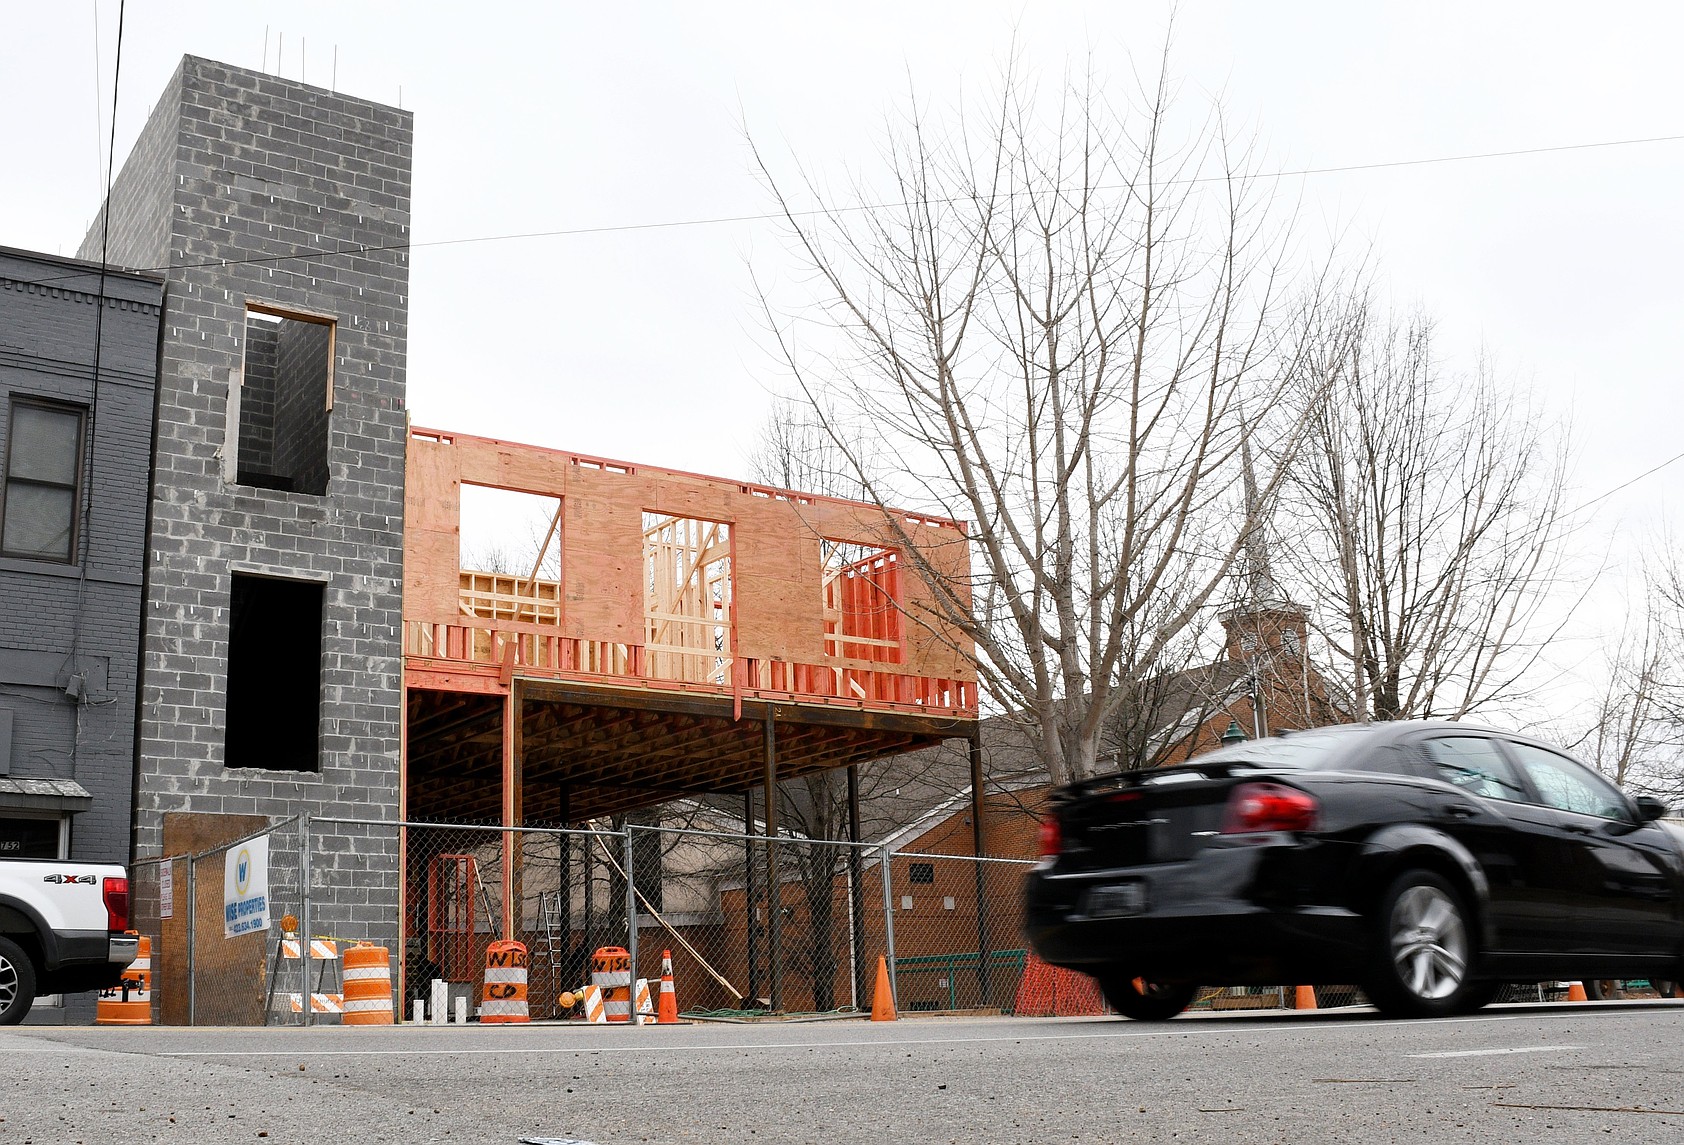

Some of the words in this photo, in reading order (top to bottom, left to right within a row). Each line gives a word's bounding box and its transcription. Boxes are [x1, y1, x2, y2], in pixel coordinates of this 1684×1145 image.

[1, 841, 20, 851] 752
[238, 861, 247, 883] W
[226, 901, 238, 923] WISE
[238, 896, 266, 917] PROPERTIES
